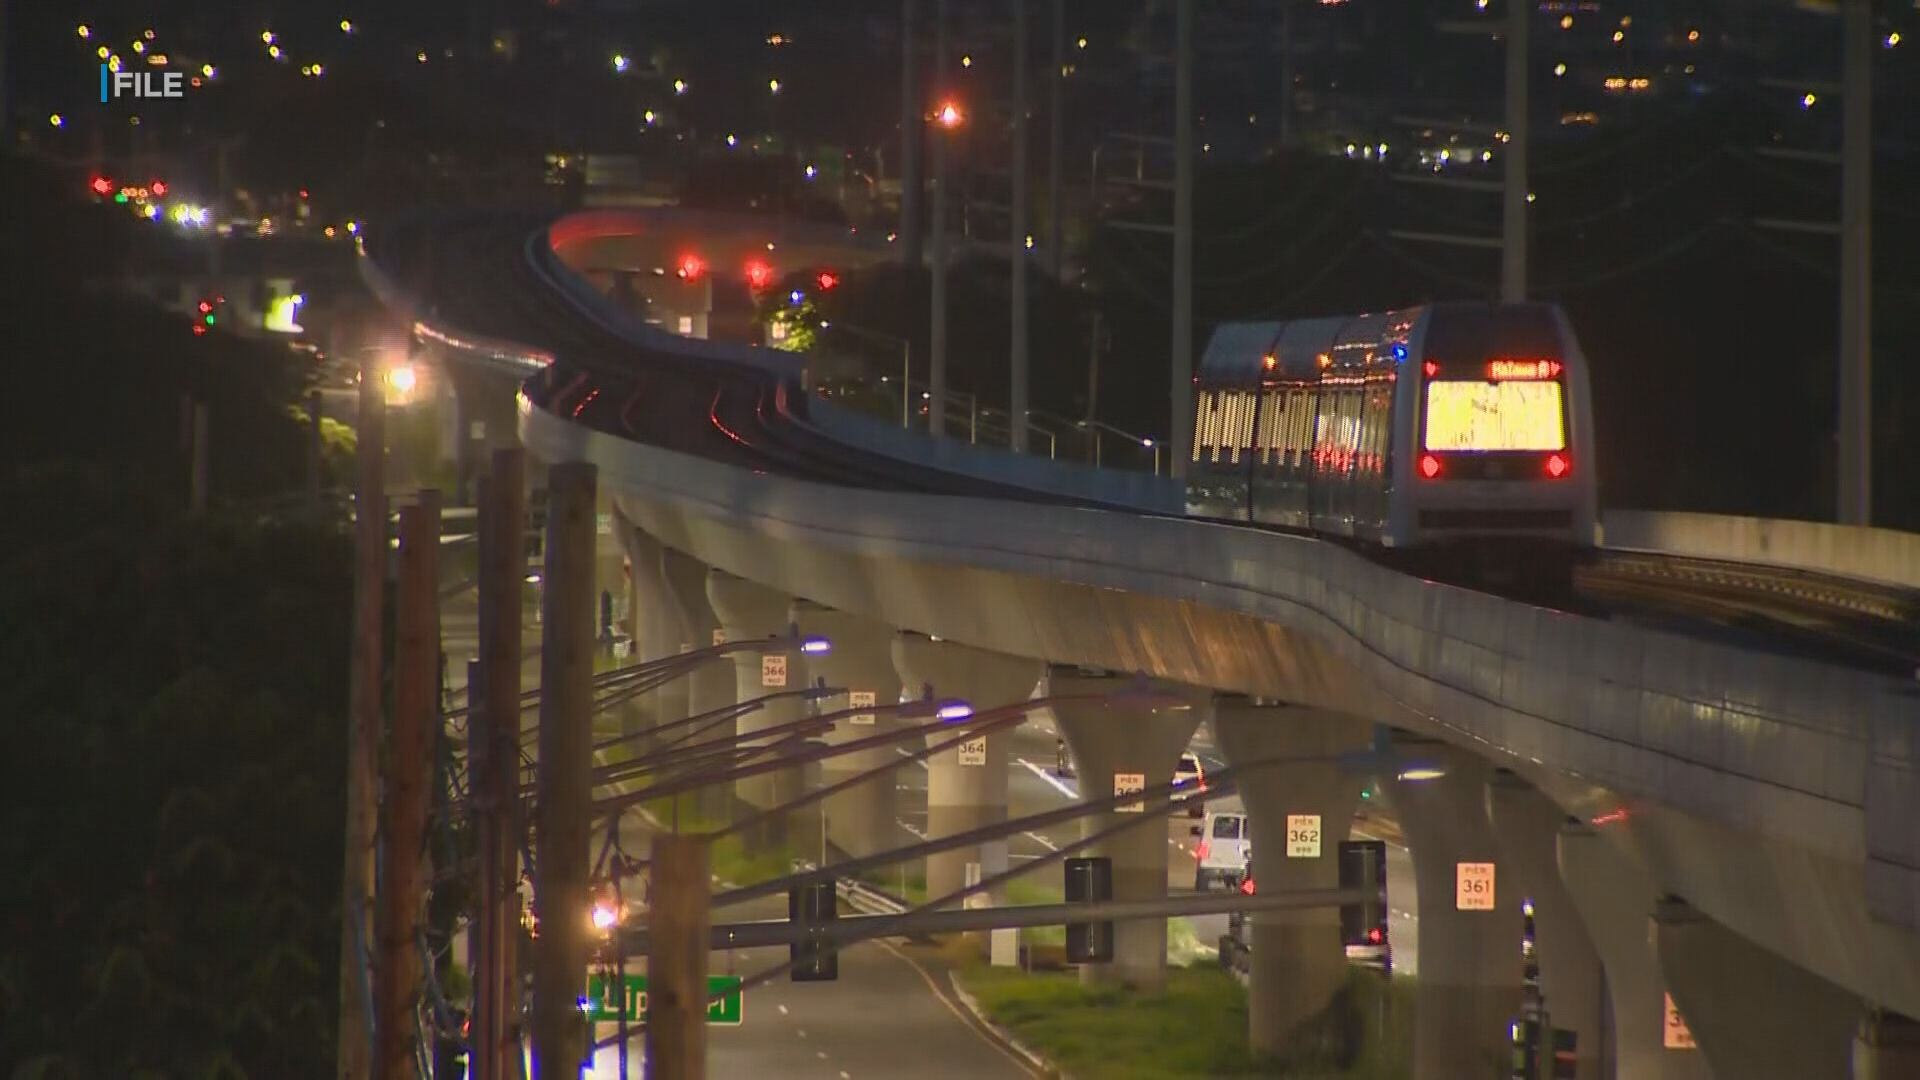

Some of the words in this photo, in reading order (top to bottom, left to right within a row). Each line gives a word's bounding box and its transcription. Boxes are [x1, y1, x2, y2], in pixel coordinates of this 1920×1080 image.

[764, 666, 785, 676] 366
[959, 743, 984, 754] 364
[1290, 830, 1318, 843] 362
[1463, 879, 1489, 893] 361
